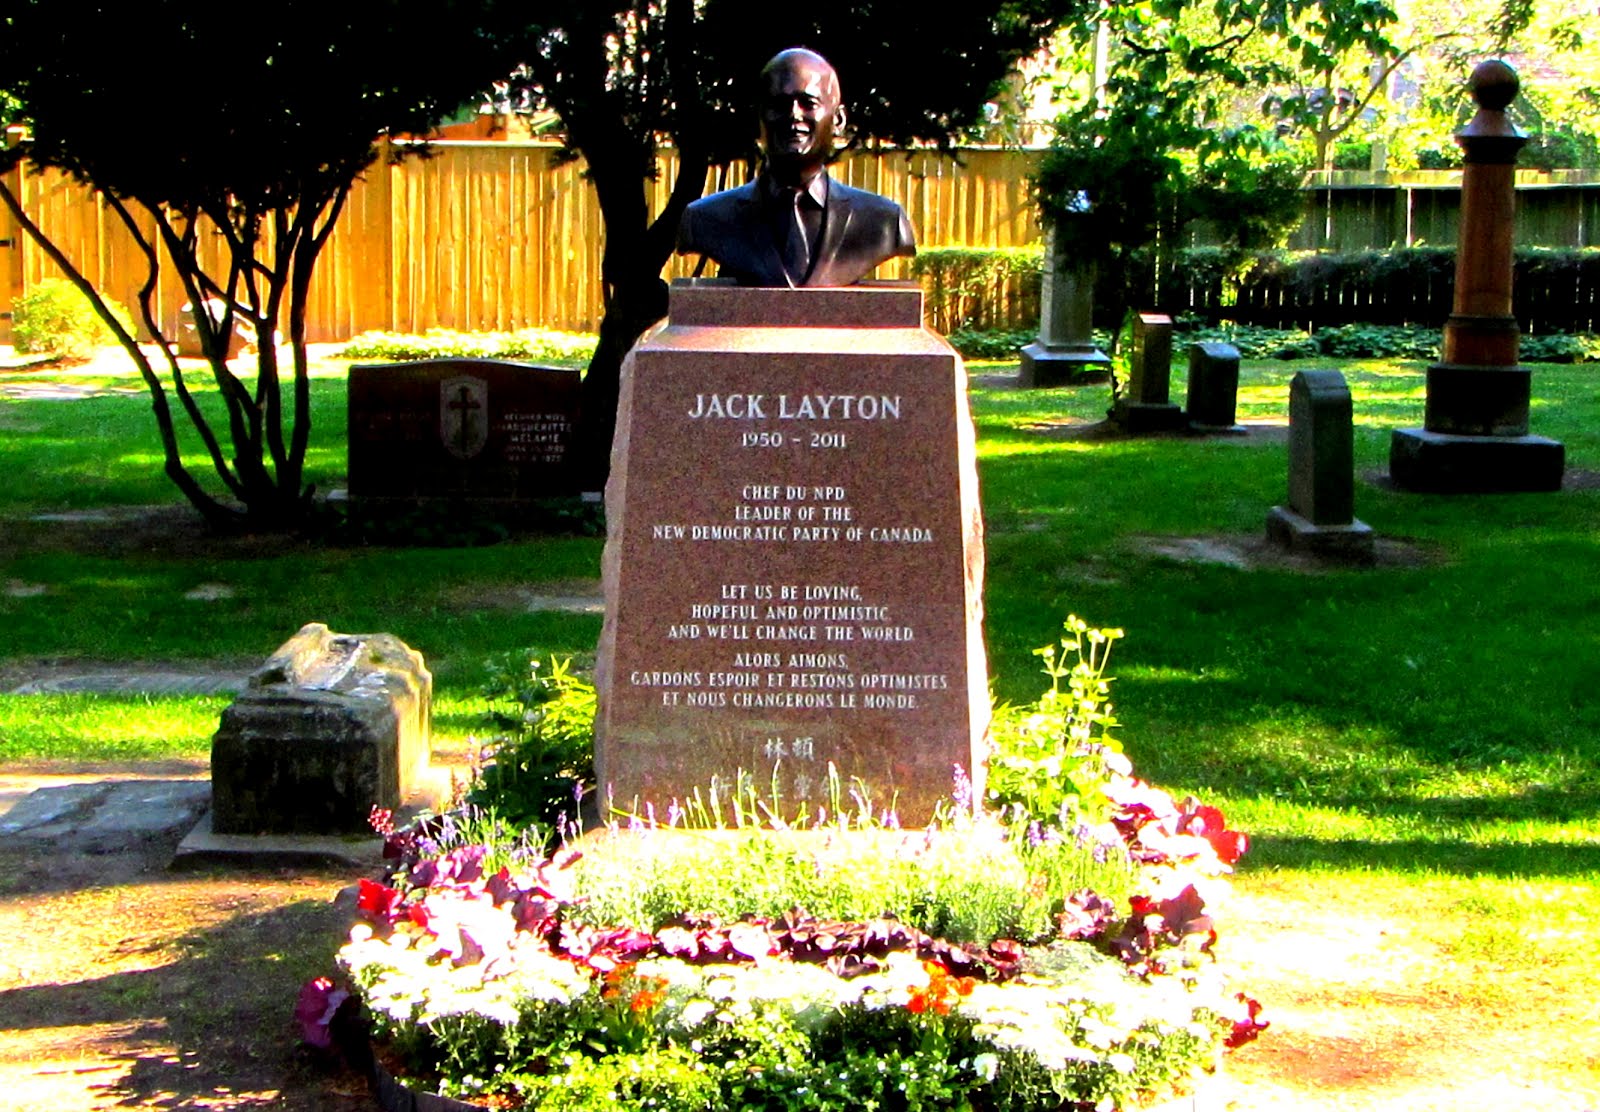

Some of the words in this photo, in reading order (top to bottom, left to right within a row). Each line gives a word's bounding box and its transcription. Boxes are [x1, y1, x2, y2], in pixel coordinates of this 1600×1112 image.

[688, 394, 767, 419] JACK
[779, 394, 902, 420] LAYTON
[742, 432, 782, 447] 1950
[810, 433, 846, 448] 2011
[742, 486, 780, 500] CHEF
[786, 486, 806, 500] DU
[814, 486, 845, 501] NPD
[735, 506, 791, 521] LEADER
[798, 507, 816, 521] OF
[822, 507, 852, 521] THE
[653, 525, 686, 540] NEW
[692, 526, 787, 541] DEMOCRATIC
[792, 527, 840, 541] PARTY
[846, 527, 864, 542] OF
[870, 528, 932, 542] CANADA
[722, 585, 747, 599] LET
[754, 586, 773, 600] US
[781, 586, 799, 600] BE
[805, 586, 863, 602] LOVING,
[692, 605, 758, 619] HOPEFUL
[765, 606, 798, 620] AND
[668, 625, 700, 639] AND
[706, 625, 749, 639] WE'LL
[756, 626, 817, 641] CHANGE
[826, 626, 853, 641] THE
[734, 653, 781, 668] ALORS
[631, 671, 702, 686] GARDONS
[709, 673, 760, 687] ESPOIR
[767, 673, 785, 687] ET
[790, 673, 854, 688] RESTONS
[860, 674, 947, 689] OPTIMISTES
[662, 693, 680, 706] ET
[686, 693, 727, 707] NOUS
[733, 693, 833, 709] CHANGERONS
[840, 694, 856, 709] LE
